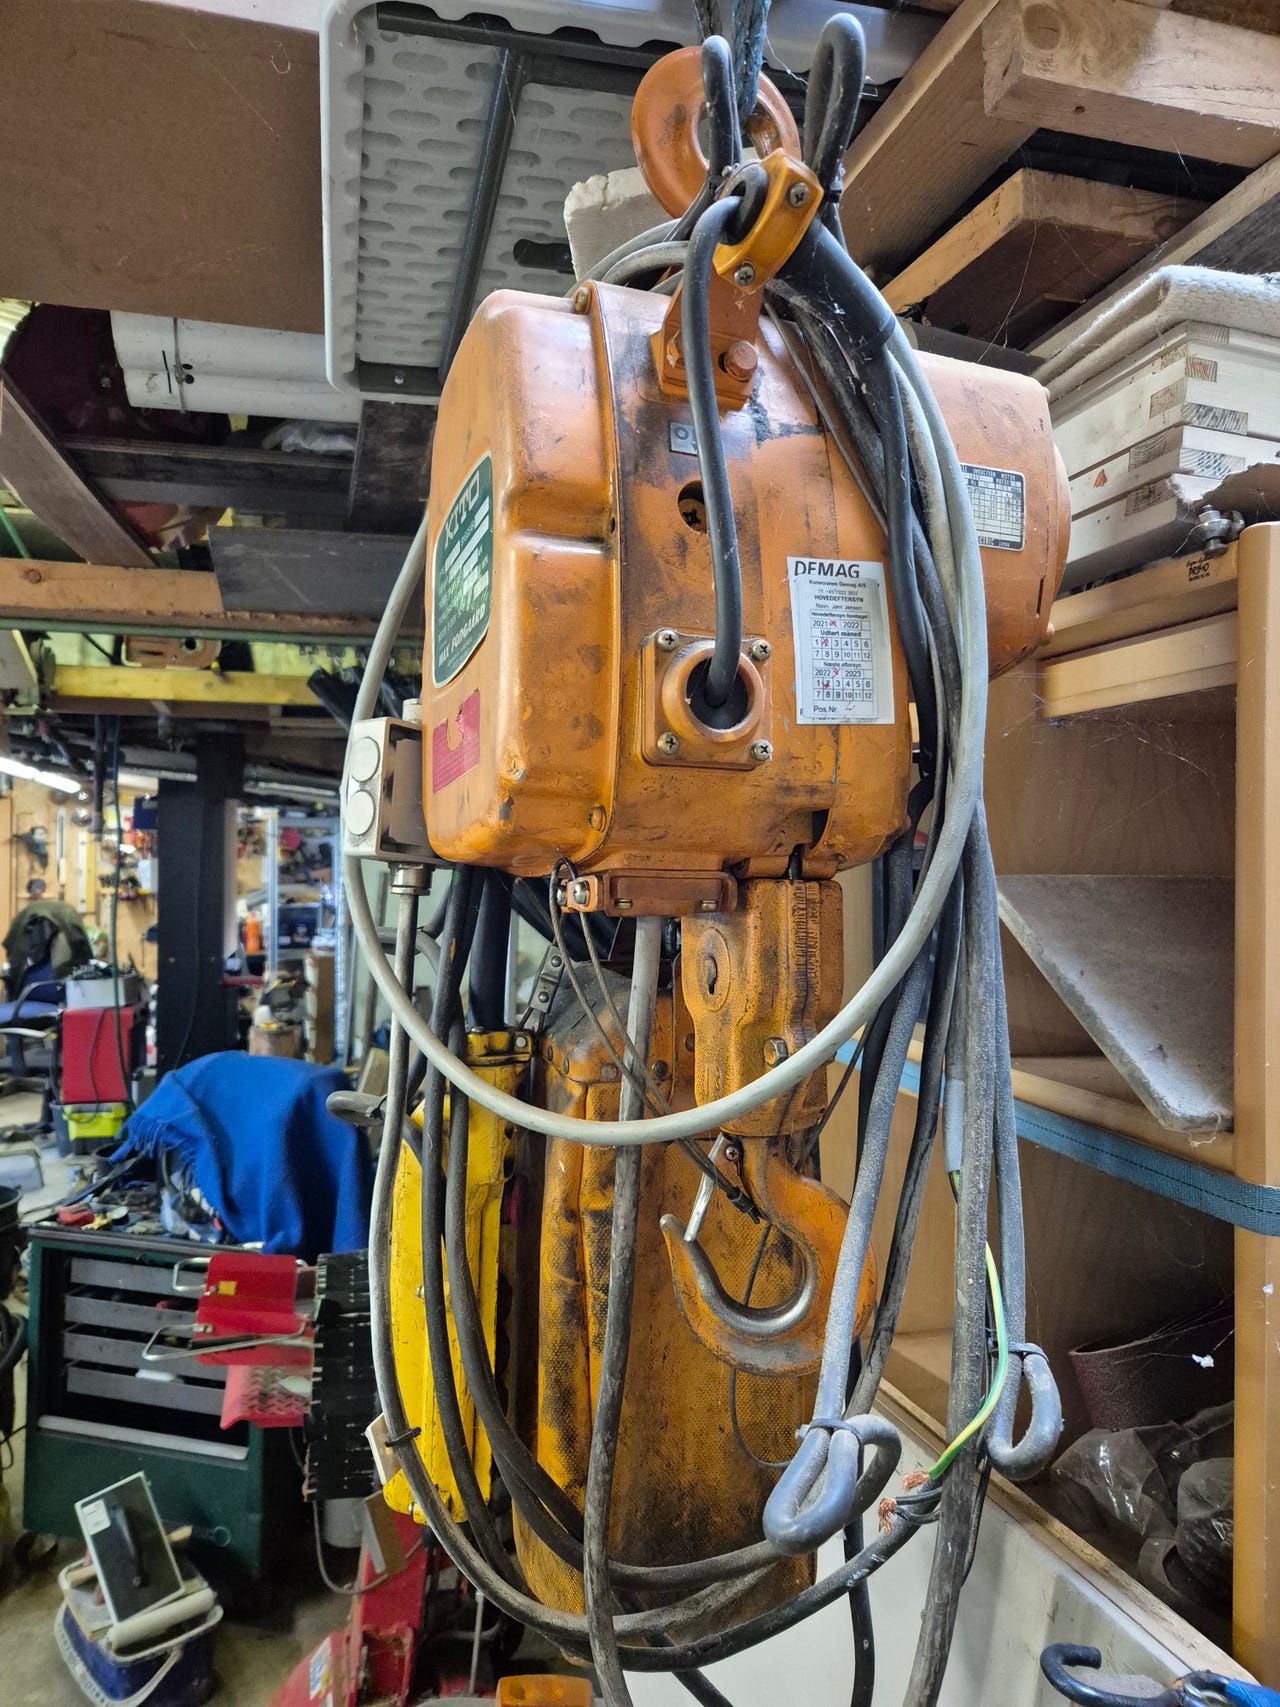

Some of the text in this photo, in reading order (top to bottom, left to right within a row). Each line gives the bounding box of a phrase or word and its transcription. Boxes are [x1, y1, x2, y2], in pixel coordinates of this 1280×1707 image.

[444, 470, 480, 550] KITO
[814, 594, 864, 603] HOVEDEFTERSYN
[811, 611, 846, 619] Hovedeftersyn
[812, 619, 860, 629] 2021 2022
[834, 639, 840, 647] 3
[854, 640, 860, 648] 5
[863, 640, 869, 648] 6
[824, 650, 830, 658] 8
[834, 650, 840, 658] 9
[853, 651, 861, 659] 11
[814, 669, 862, 678] 2022 2023
[825, 691, 831, 699] 8
[835, 691, 841, 699] 9
